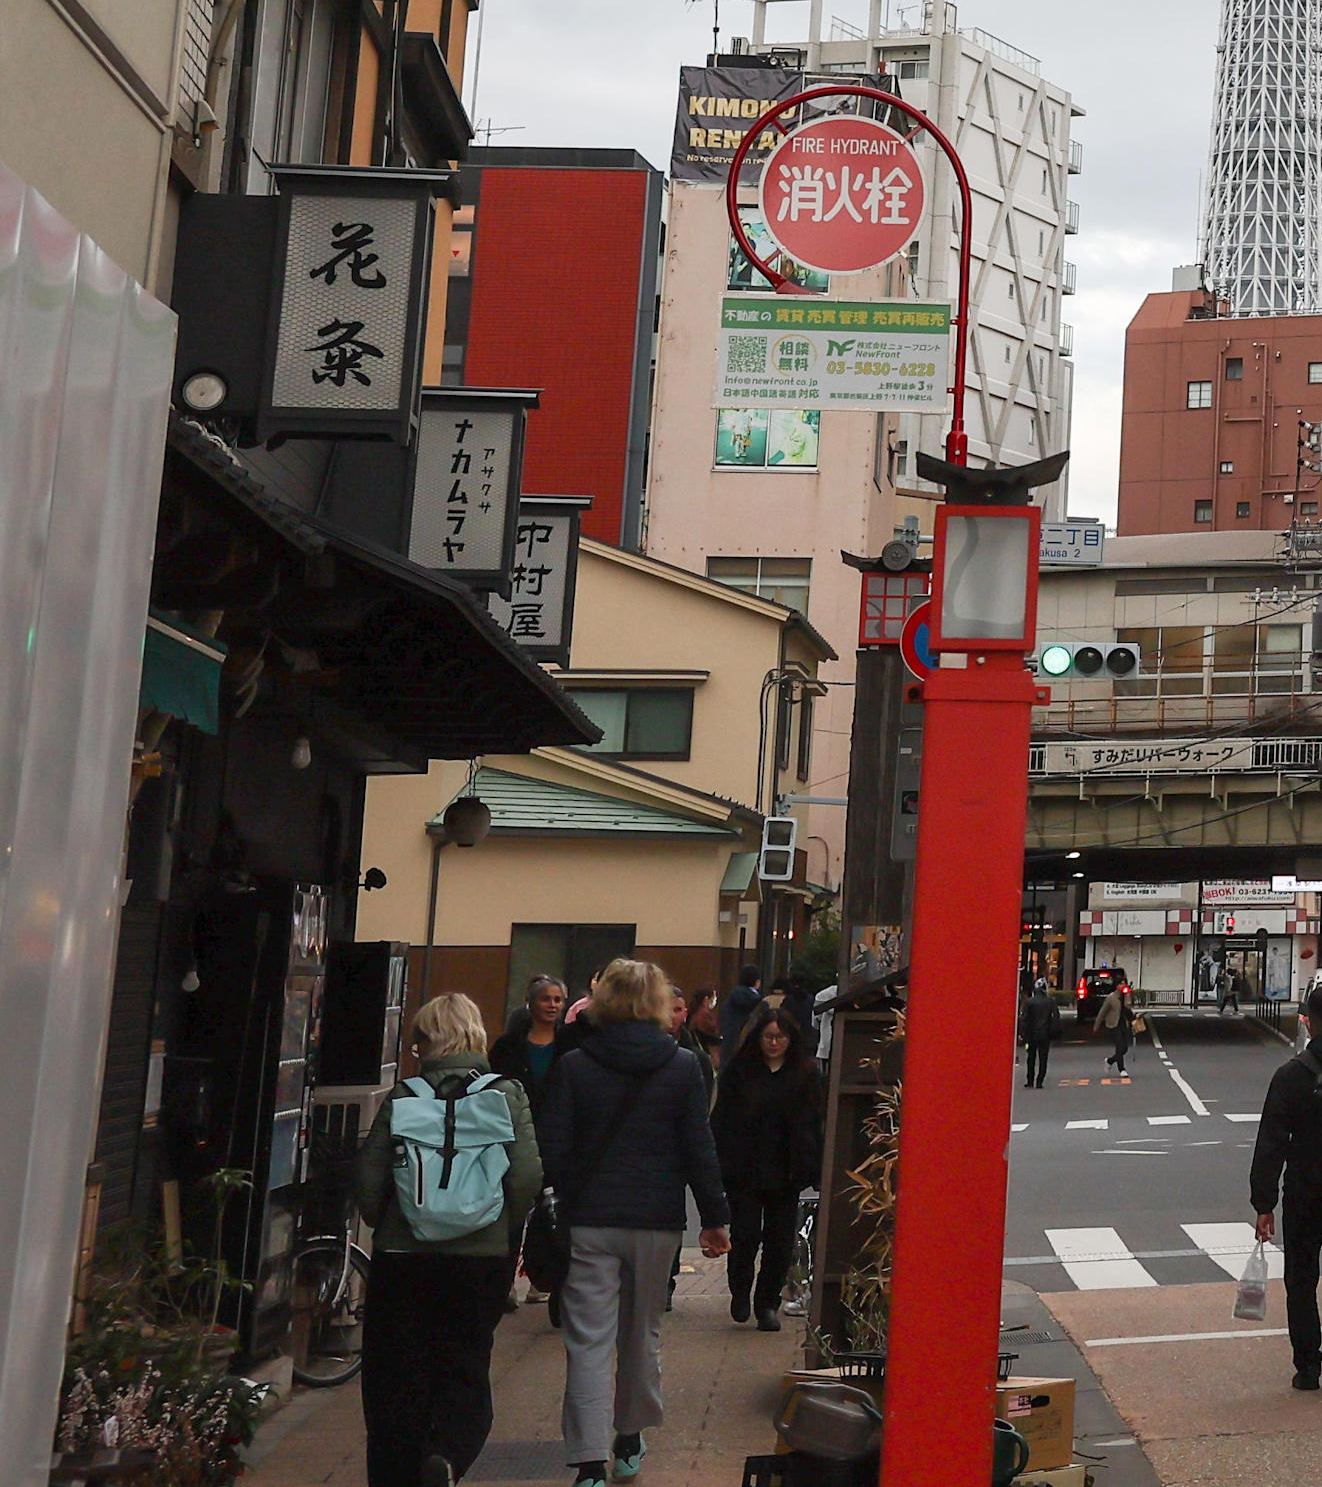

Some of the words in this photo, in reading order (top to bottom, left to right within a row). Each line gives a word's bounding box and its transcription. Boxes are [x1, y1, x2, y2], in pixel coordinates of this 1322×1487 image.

[792, 137, 825, 154] FIRE
[830, 138, 899, 156] HYDRANT
[777, 164, 913, 225] 消火栓
[725, 309, 772, 322] 不動産の
[779, 341, 810, 356] 相談
[855, 350, 902, 359] NewFront
[778, 357, 809, 372] 無料
[481, 447, 497, 513] アサクサ
[441, 418, 474, 563] ナカムラヤ
[1040, 528, 1099, 547] 二丁目
[1073, 548, 1081, 559] 2
[506, 521, 554, 638] 中村屋
[1092, 747, 1234, 763] すみだリバーウォーク
